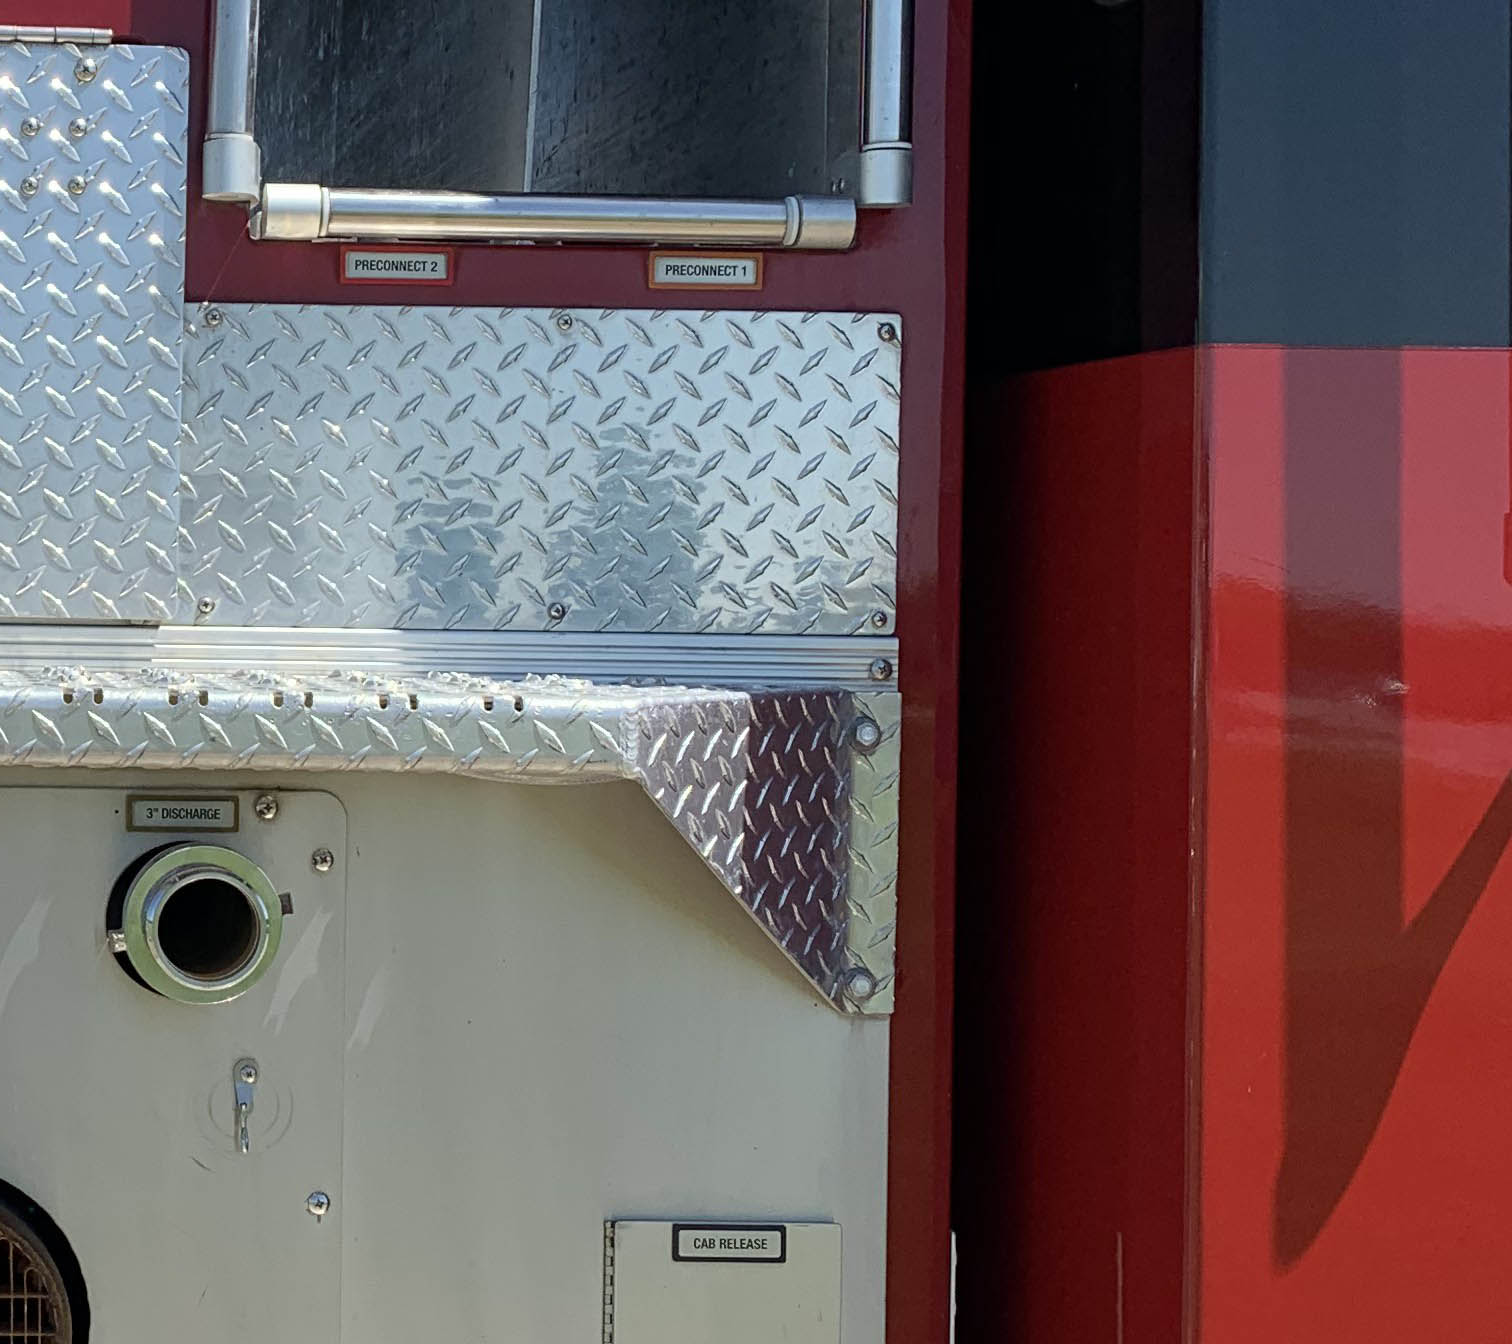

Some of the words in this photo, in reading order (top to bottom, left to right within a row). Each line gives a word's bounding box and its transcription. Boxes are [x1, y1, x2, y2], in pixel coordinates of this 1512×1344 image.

[354, 259, 428, 272] PRECONNECT
[430, 261, 438, 272] 2
[665, 264, 739, 277] PRECONNECT
[741, 266, 747, 277] 1
[161, 807, 221, 820] DISCHARGE
[693, 1237, 716, 1249] CAB
[719, 1238, 768, 1250] RELEASE
